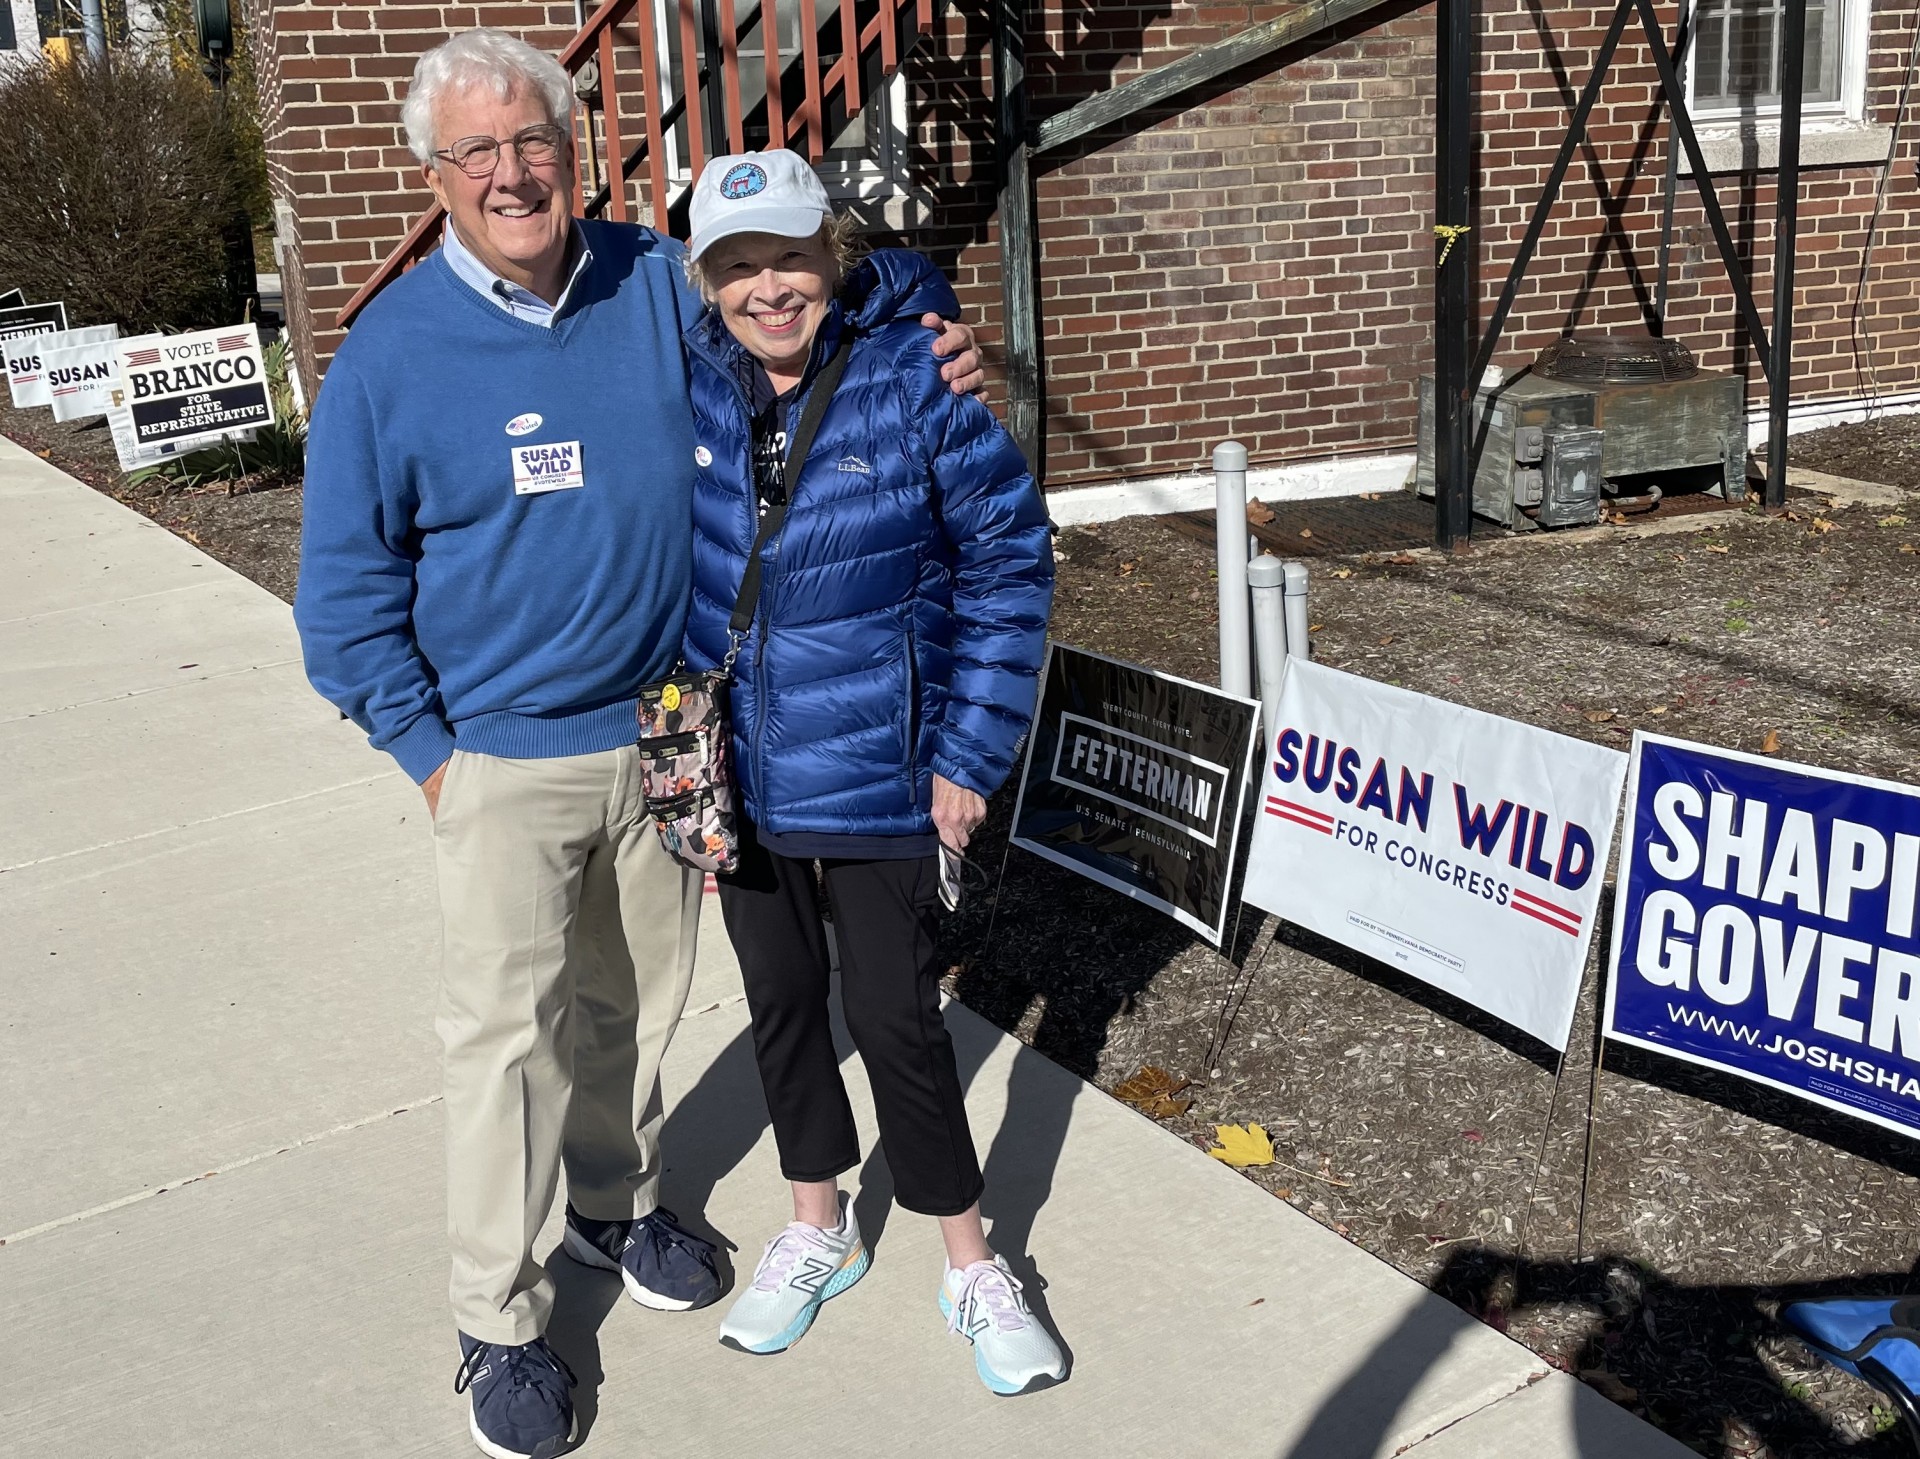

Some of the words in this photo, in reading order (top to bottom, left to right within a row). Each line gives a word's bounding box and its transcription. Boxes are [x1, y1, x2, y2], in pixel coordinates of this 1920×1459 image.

[9, 355, 42, 374] SUS
[164, 341, 214, 361] VOTE
[48, 361, 110, 386] SUSAN
[78, 383, 95, 392] FOR
[129, 355, 256, 399] BRANCO
[179, 401, 223, 418] STATE
[186, 393, 212, 405] FOR
[139, 403, 266, 436] REPRESENTATIVE
[520, 445, 574, 463] SUSAN
[525, 459, 572, 475] WILD
[1102, 701, 1122, 713] EVERY
[1152, 718, 1171, 731] EVERY
[1173, 726, 1193, 739] VOTE.
[1070, 733, 1212, 821] FETTERMAN
[1272, 726, 1435, 834] SUSAN
[1452, 781, 1596, 891] WILD
[1075, 804, 1092, 818] U.S.
[1094, 811, 1126, 831] SENATE
[1135, 827, 1191, 861] PENNSYLVANIA
[1335, 819, 1378, 855] FOR
[1384, 839, 1511, 906] CONGRESS
[1648, 781, 1920, 939] SHAPI
[1360, 920, 1370, 928] FOR
[1377, 926, 1385, 934] THE
[1418, 945, 1447, 961] DEMOCRATIC
[1447, 958, 1462, 968] PARTY
[1636, 889, 1920, 1063] GOVER
[1667, 1002, 1920, 1101] WWW.JOSHSHA
[1823, 1083, 1835, 1092] FOR
[1867, 1098, 1878, 1107] FOR
